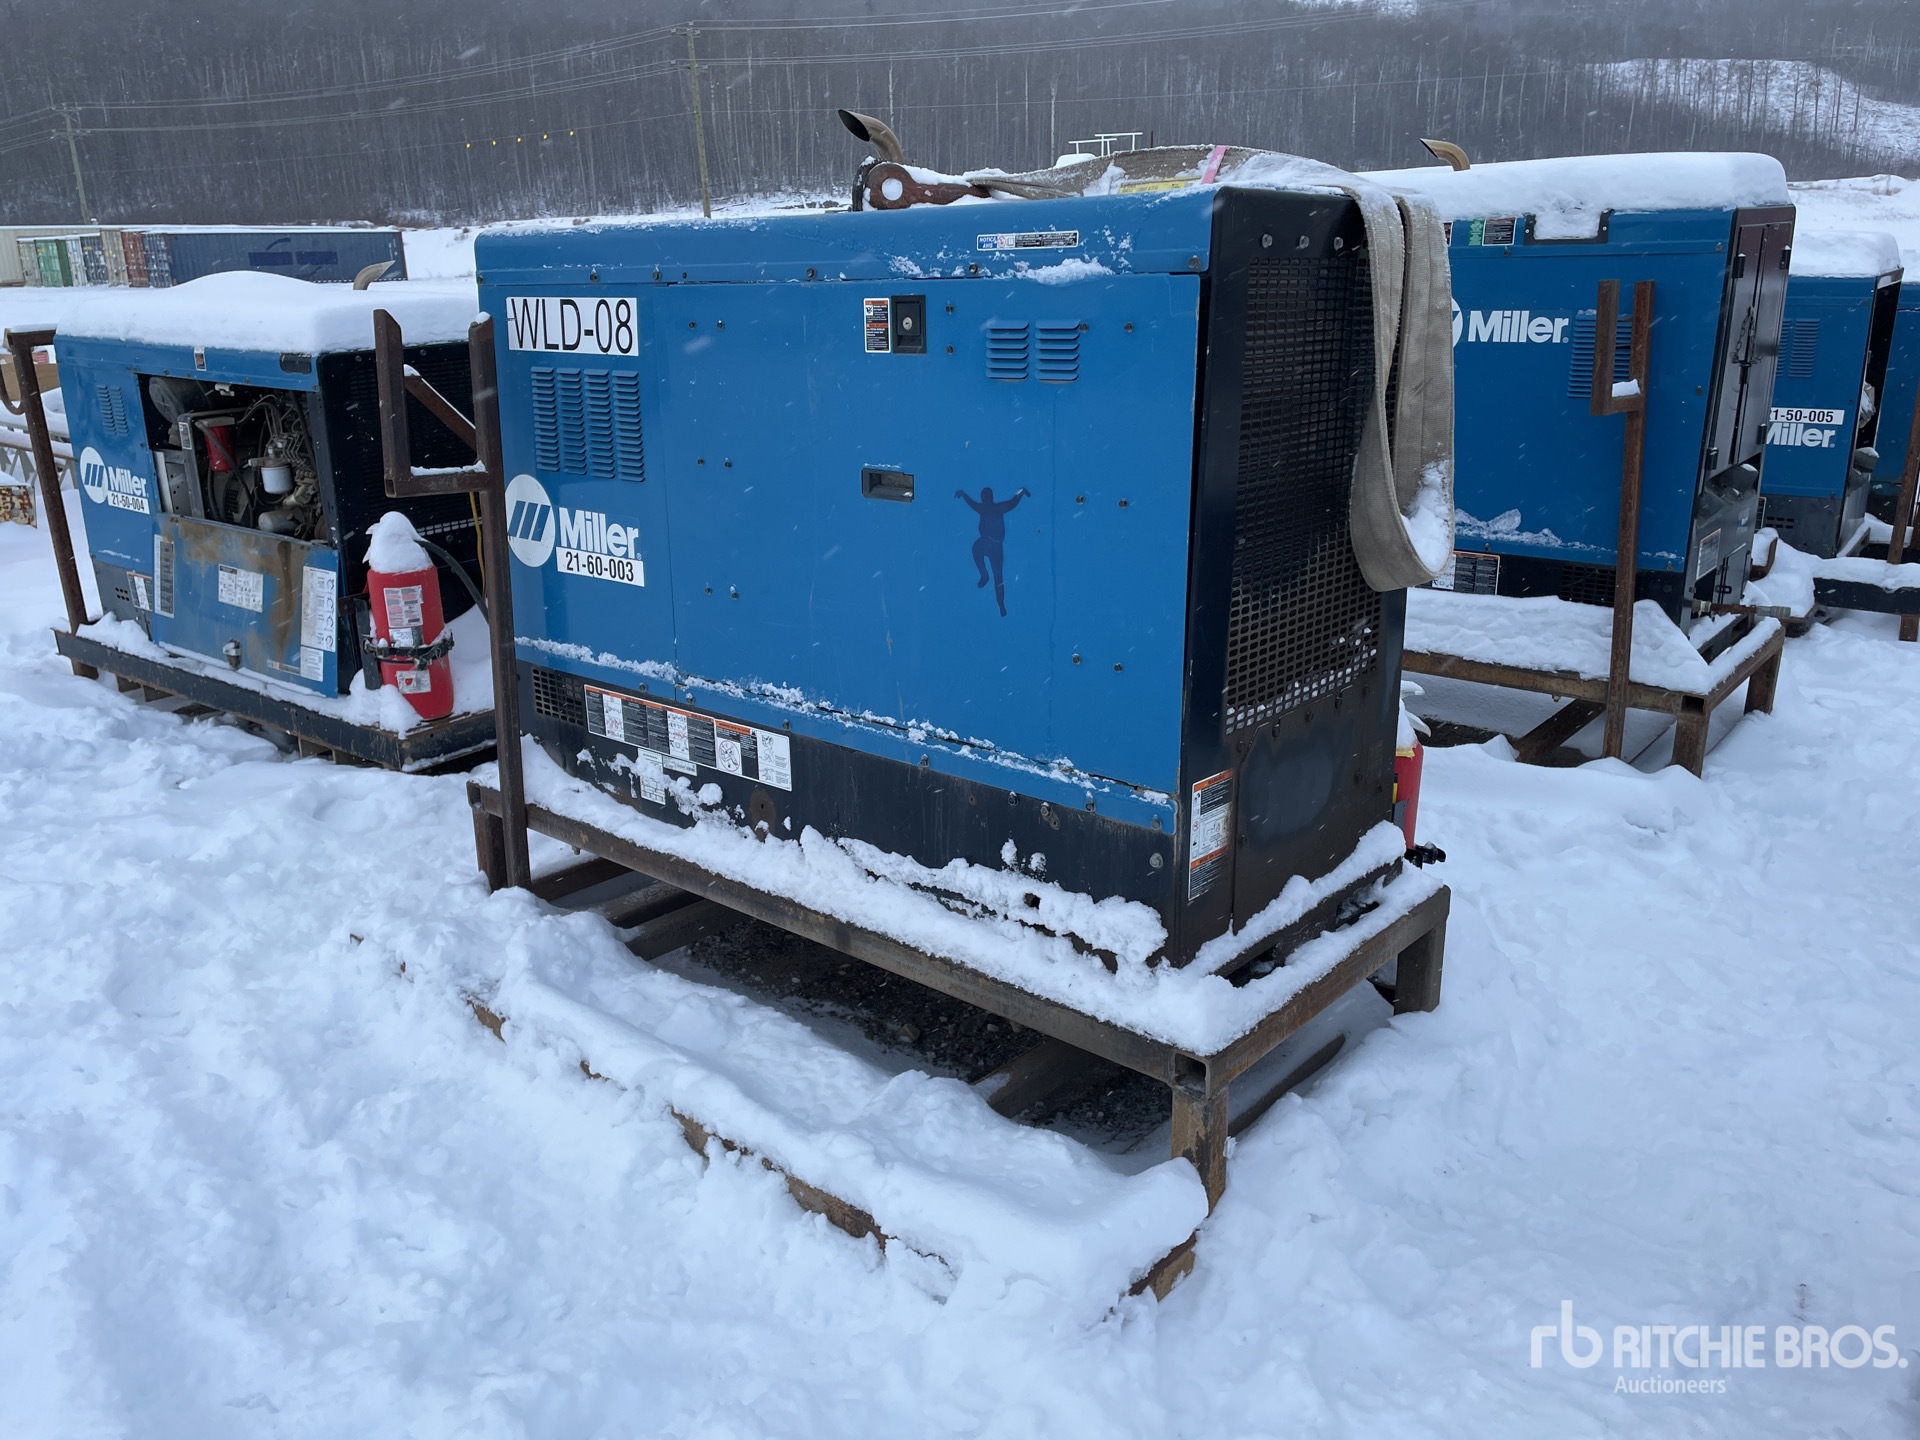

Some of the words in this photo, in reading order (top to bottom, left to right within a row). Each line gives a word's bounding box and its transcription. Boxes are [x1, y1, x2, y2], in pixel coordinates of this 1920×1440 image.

[511, 298, 633, 354] WLD-08
[1467, 310, 1569, 343] Miller
[1770, 409, 1834, 423] 1-50-005
[108, 466, 147, 497] Miller
[111, 492, 145, 512] 21-50-004
[558, 506, 640, 559] Miller
[565, 551, 635, 582] 21-60-003
